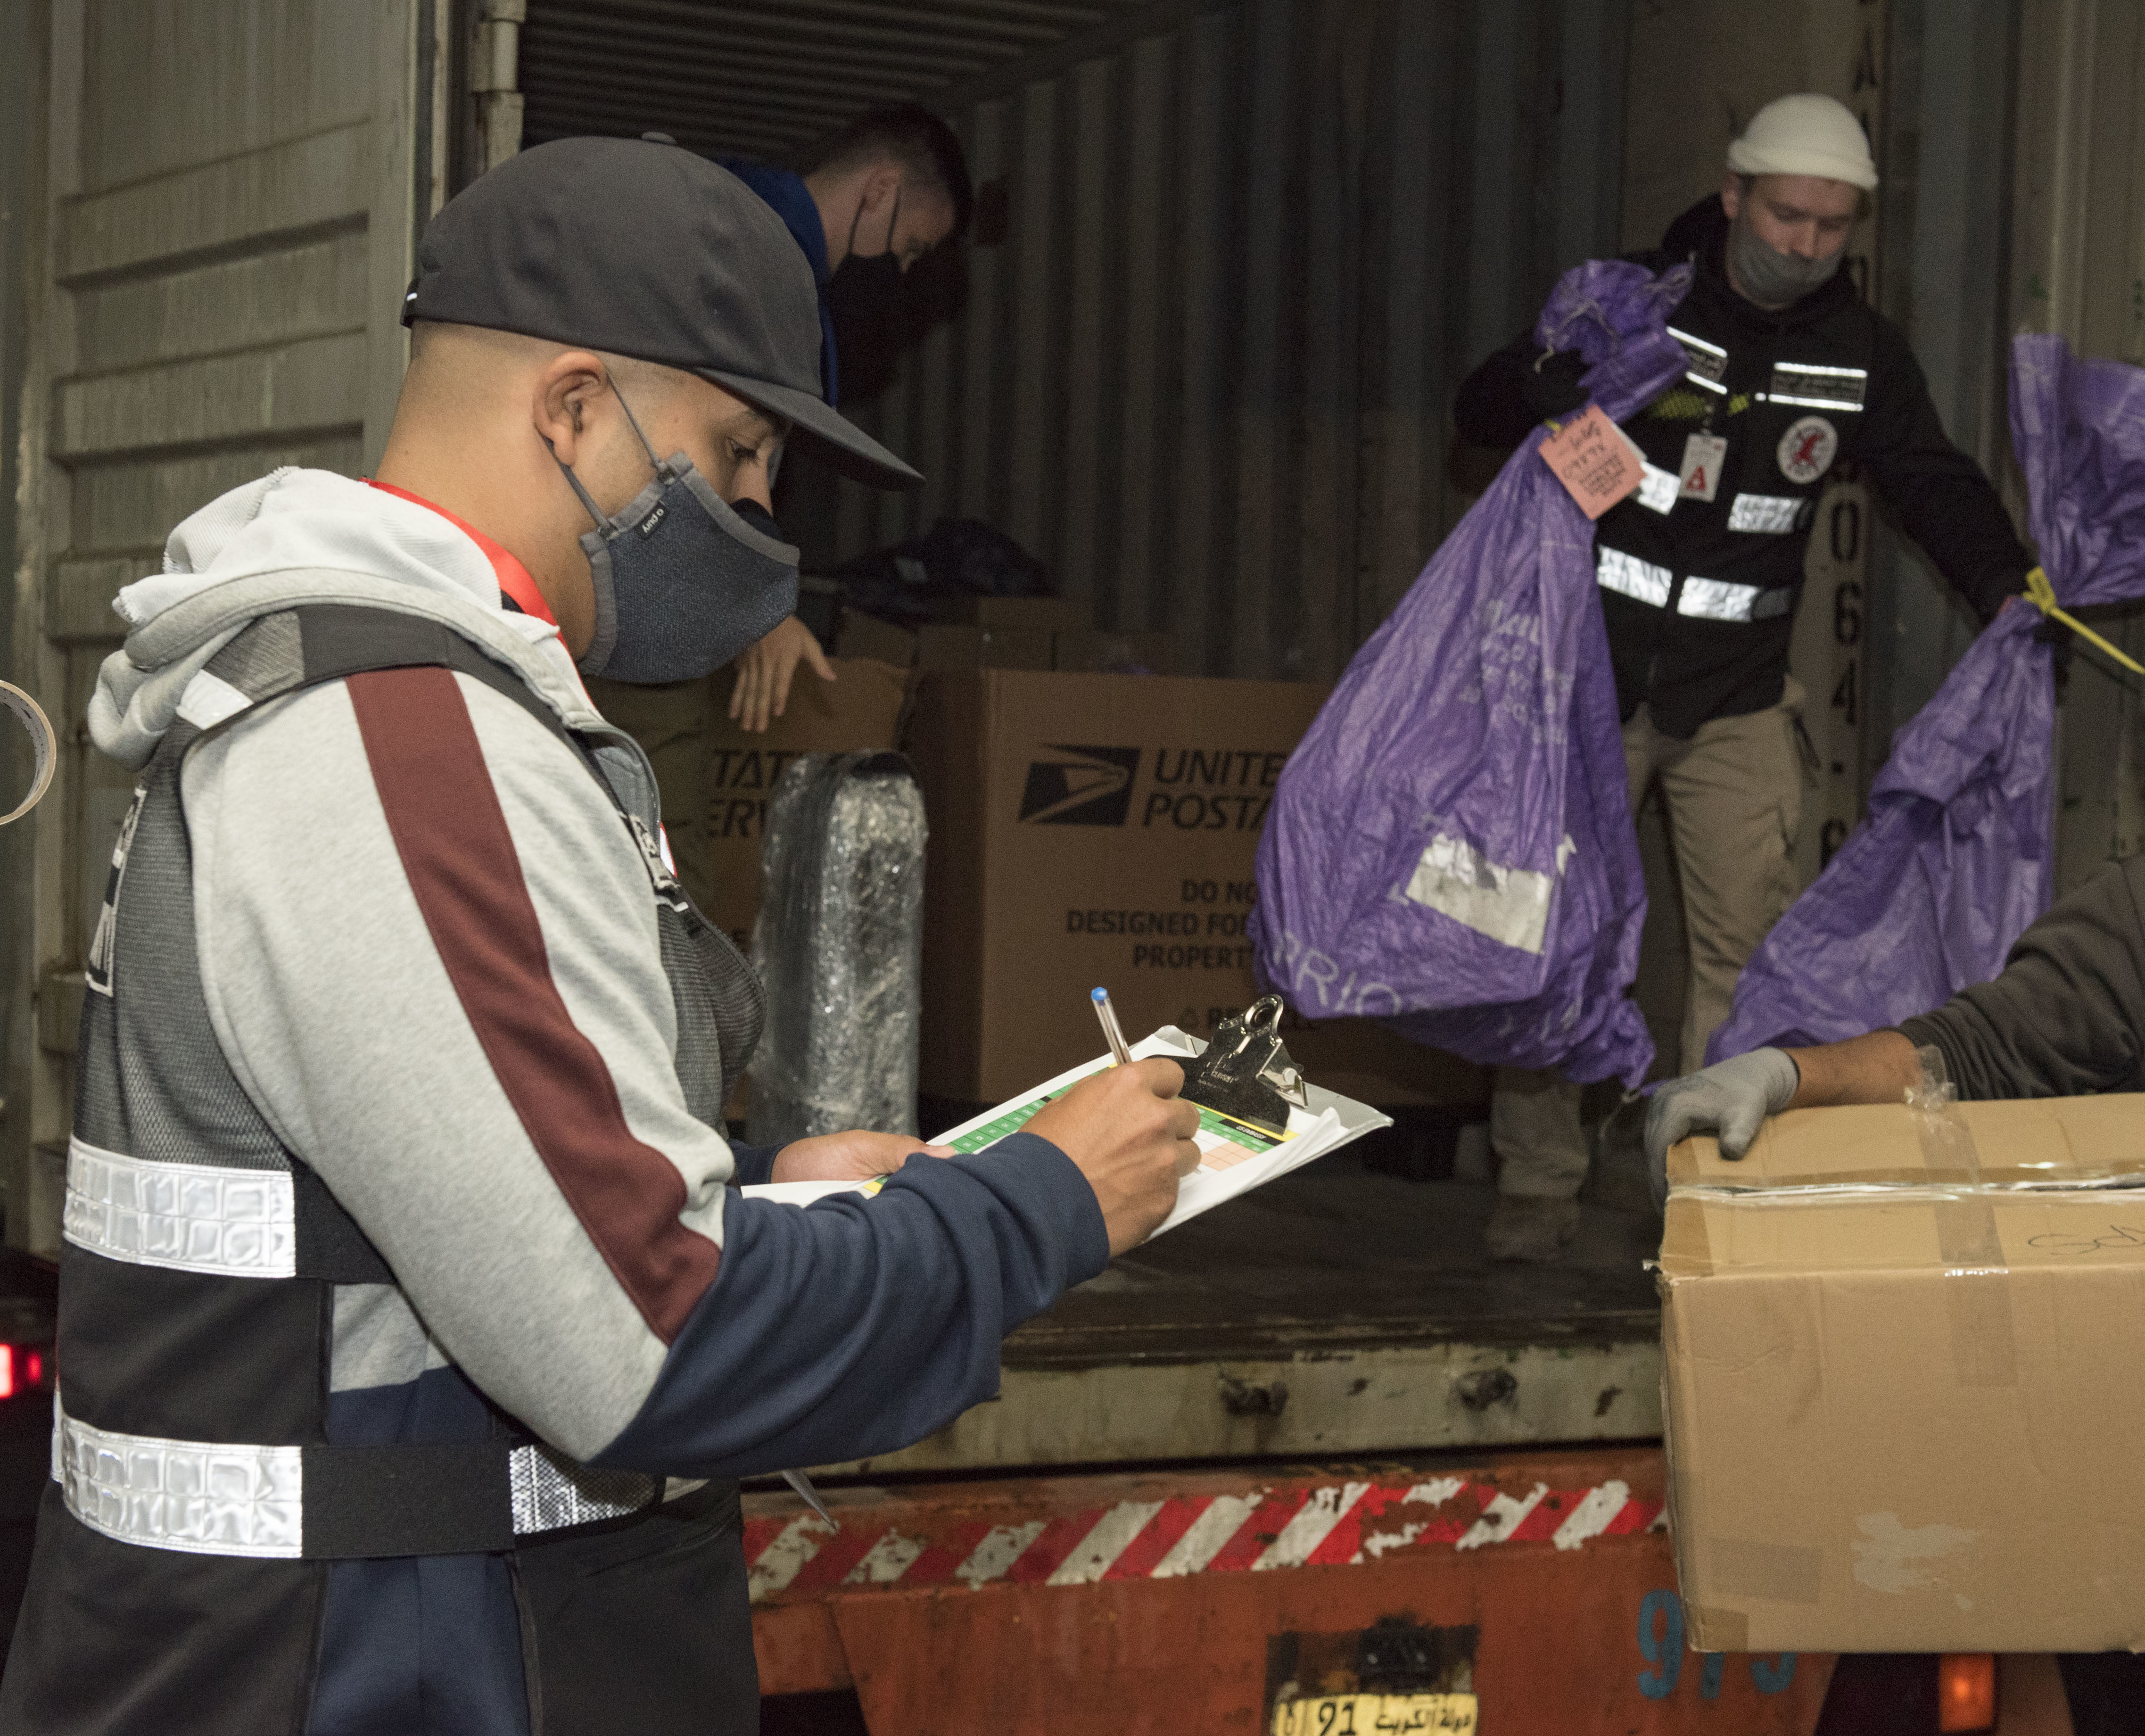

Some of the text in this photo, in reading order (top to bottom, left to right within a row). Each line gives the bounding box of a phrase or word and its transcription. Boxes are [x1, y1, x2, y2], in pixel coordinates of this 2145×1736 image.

[714, 748, 803, 788] TAT
[1182, 880, 1218, 903] DO
[1067, 910, 1198, 935] DESIGNED
[1133, 946, 1255, 970] PROPERT
[1319, 1702, 1358, 1736] 91
